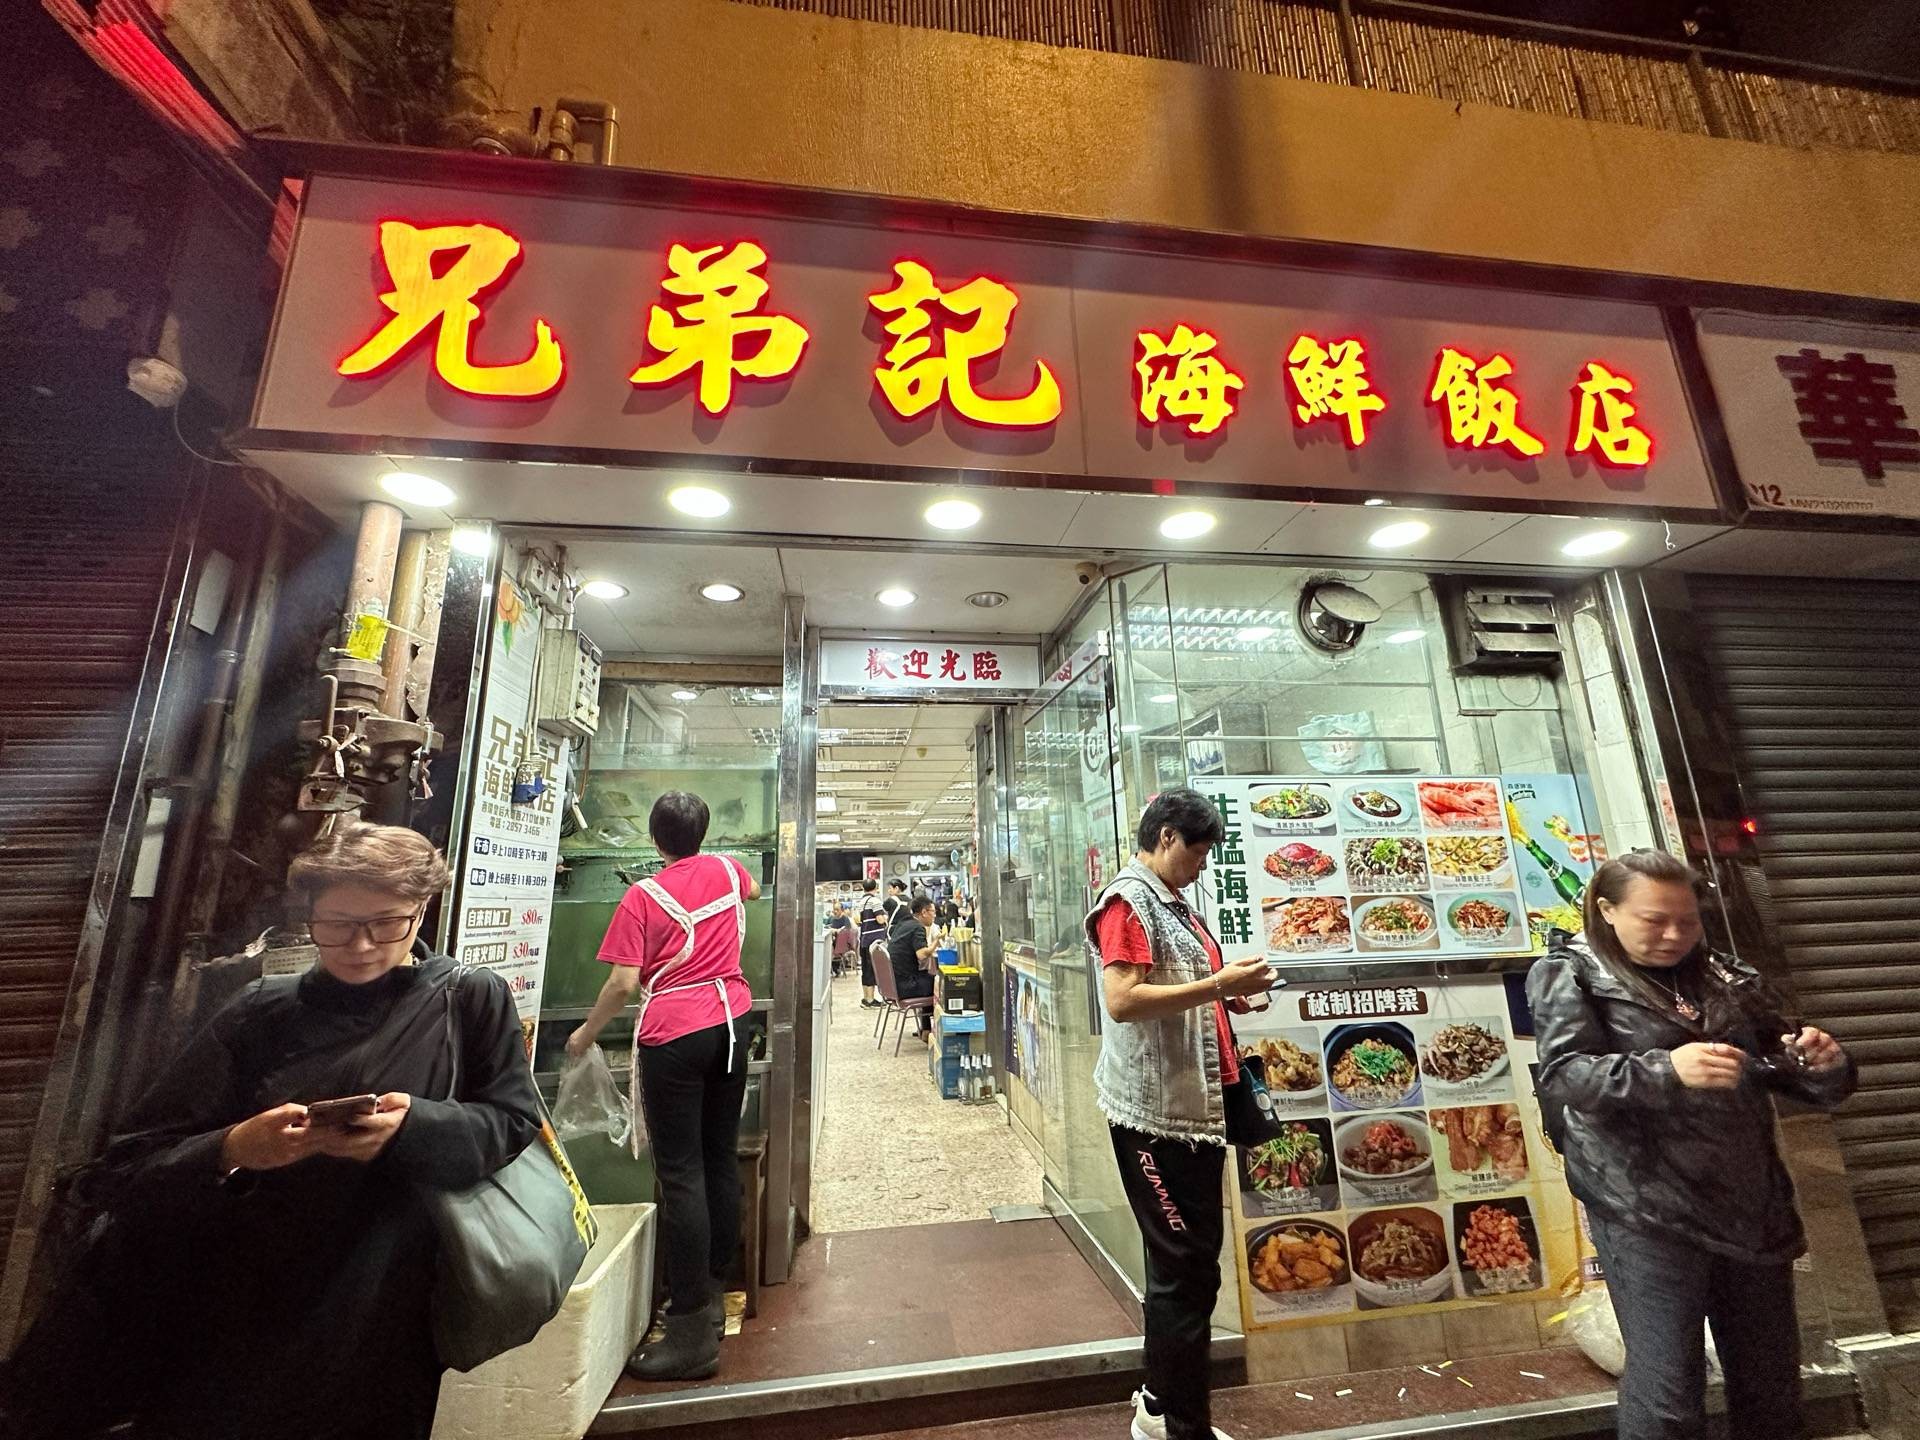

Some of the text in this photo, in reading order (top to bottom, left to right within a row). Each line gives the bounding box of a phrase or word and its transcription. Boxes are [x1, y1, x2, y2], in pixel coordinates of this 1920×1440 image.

[1775, 348, 1920, 480] 華
[864, 648, 1002, 681] 歡迎光臨
[1208, 793, 1253, 944] 生猛海鮮
[1306, 987, 1420, 1017] 秘制招牌菜
[1137, 1150, 1187, 1231] RUNNING
